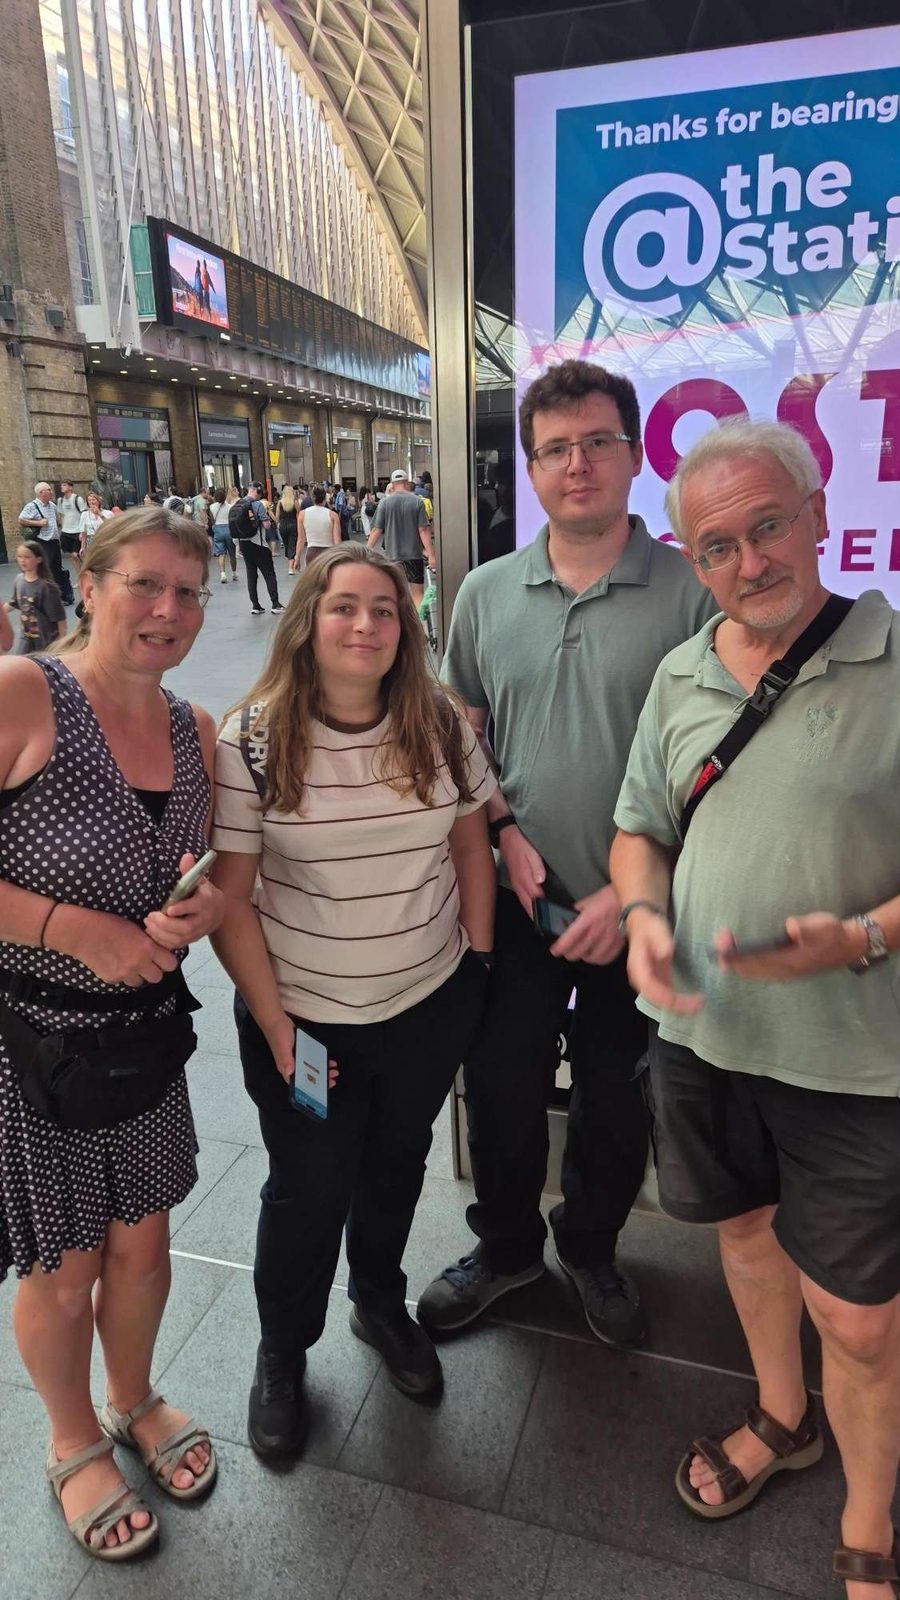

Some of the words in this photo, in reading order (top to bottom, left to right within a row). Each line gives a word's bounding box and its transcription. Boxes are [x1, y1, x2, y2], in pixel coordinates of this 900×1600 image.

[595, 114, 708, 149] Thanks
[715, 108, 762, 135] for
[770, 91, 900, 130] bearing
[720, 153, 852, 220] the
